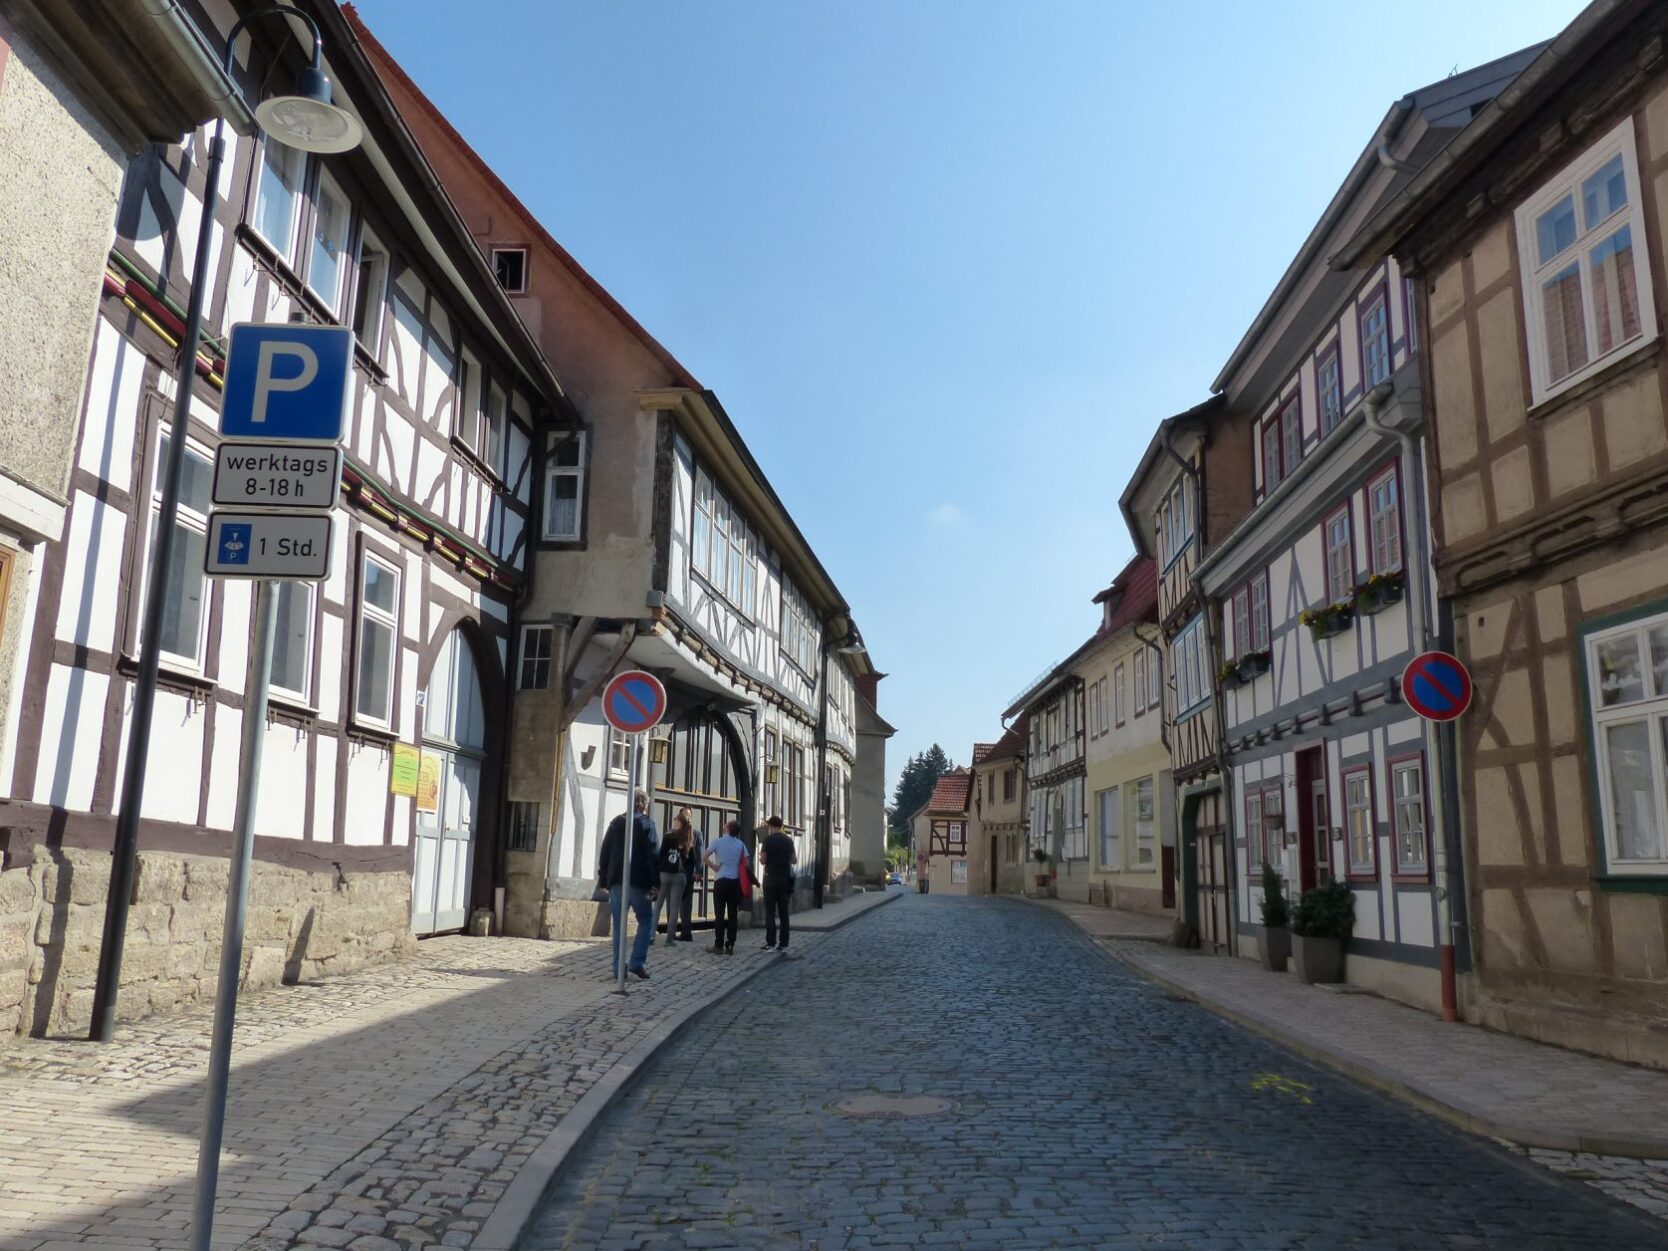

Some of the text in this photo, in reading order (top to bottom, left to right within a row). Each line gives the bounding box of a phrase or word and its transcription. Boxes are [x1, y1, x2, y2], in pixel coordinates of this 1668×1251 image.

[251, 340, 319, 423] P
[227, 453, 328, 476] werktags
[295, 480, 304, 497] h
[259, 538, 317, 557] 1 Std.
